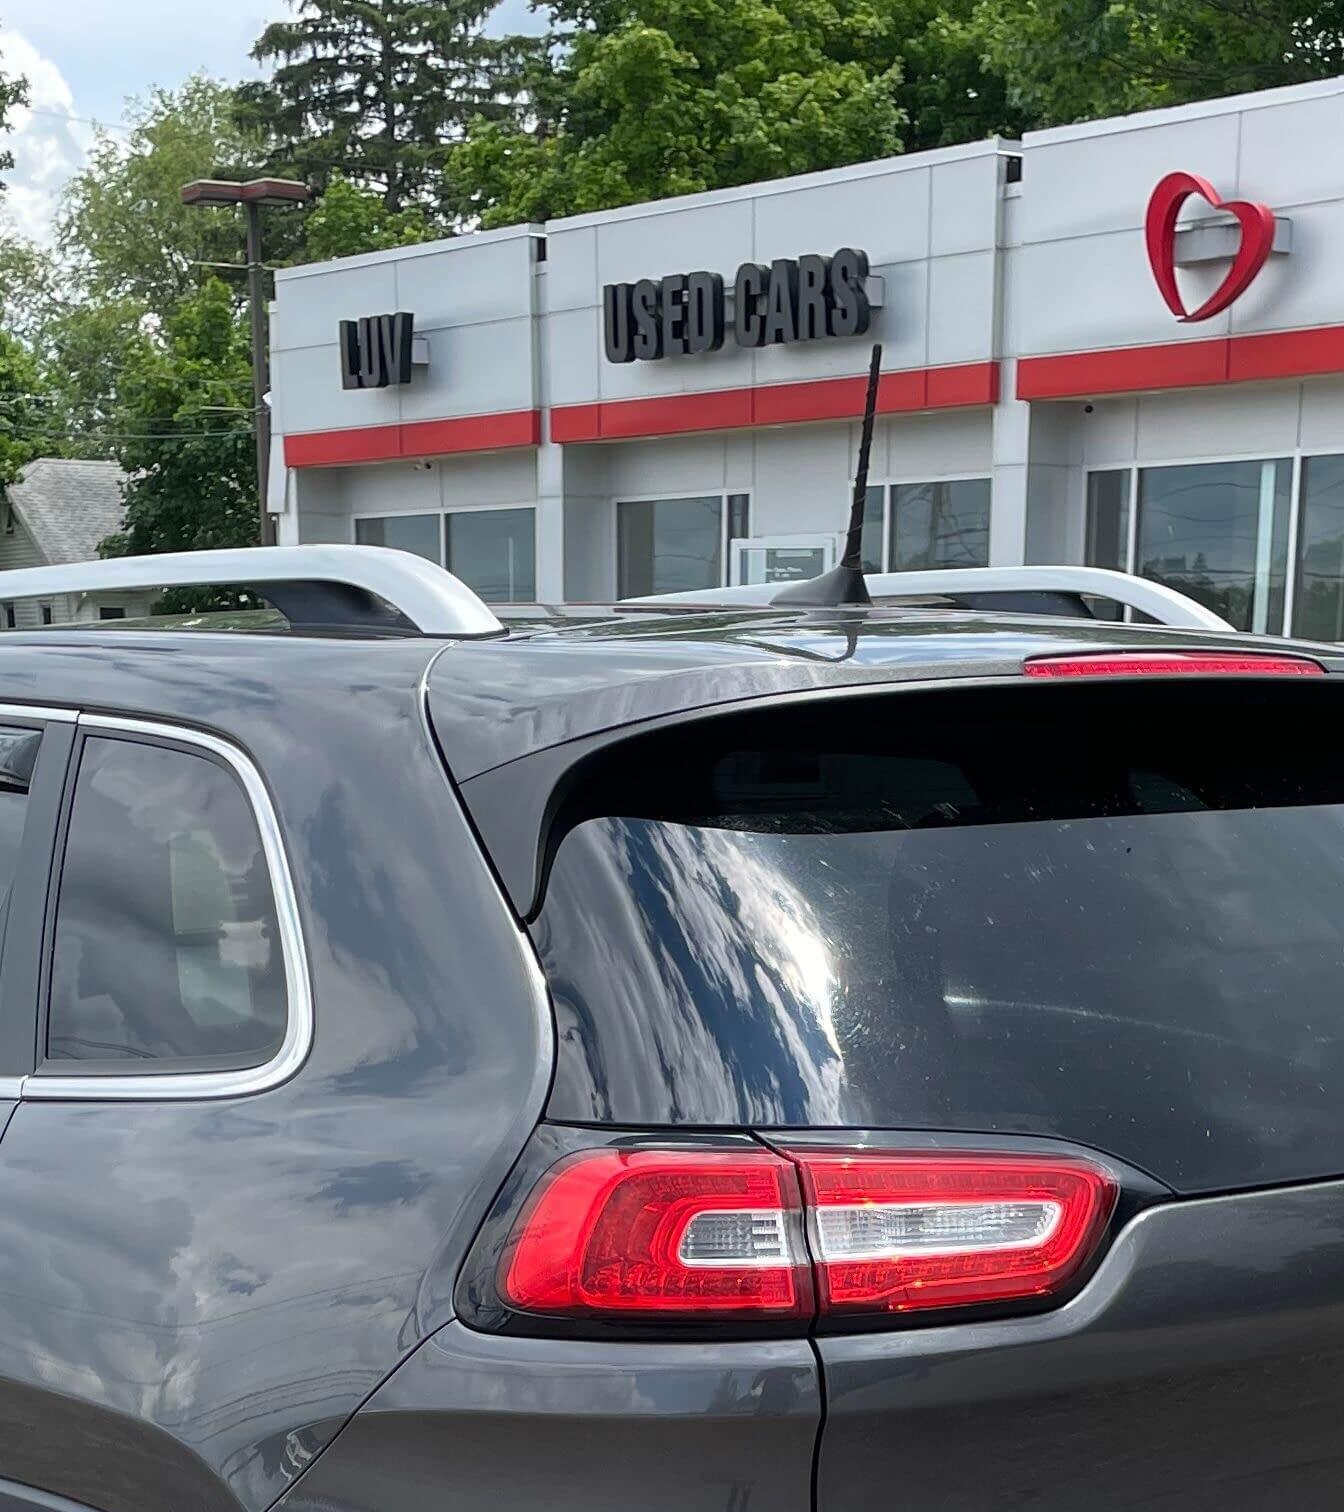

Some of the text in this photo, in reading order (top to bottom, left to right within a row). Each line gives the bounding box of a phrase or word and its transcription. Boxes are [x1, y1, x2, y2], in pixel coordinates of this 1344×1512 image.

[339, 247, 870, 390] LUV USED CARS
